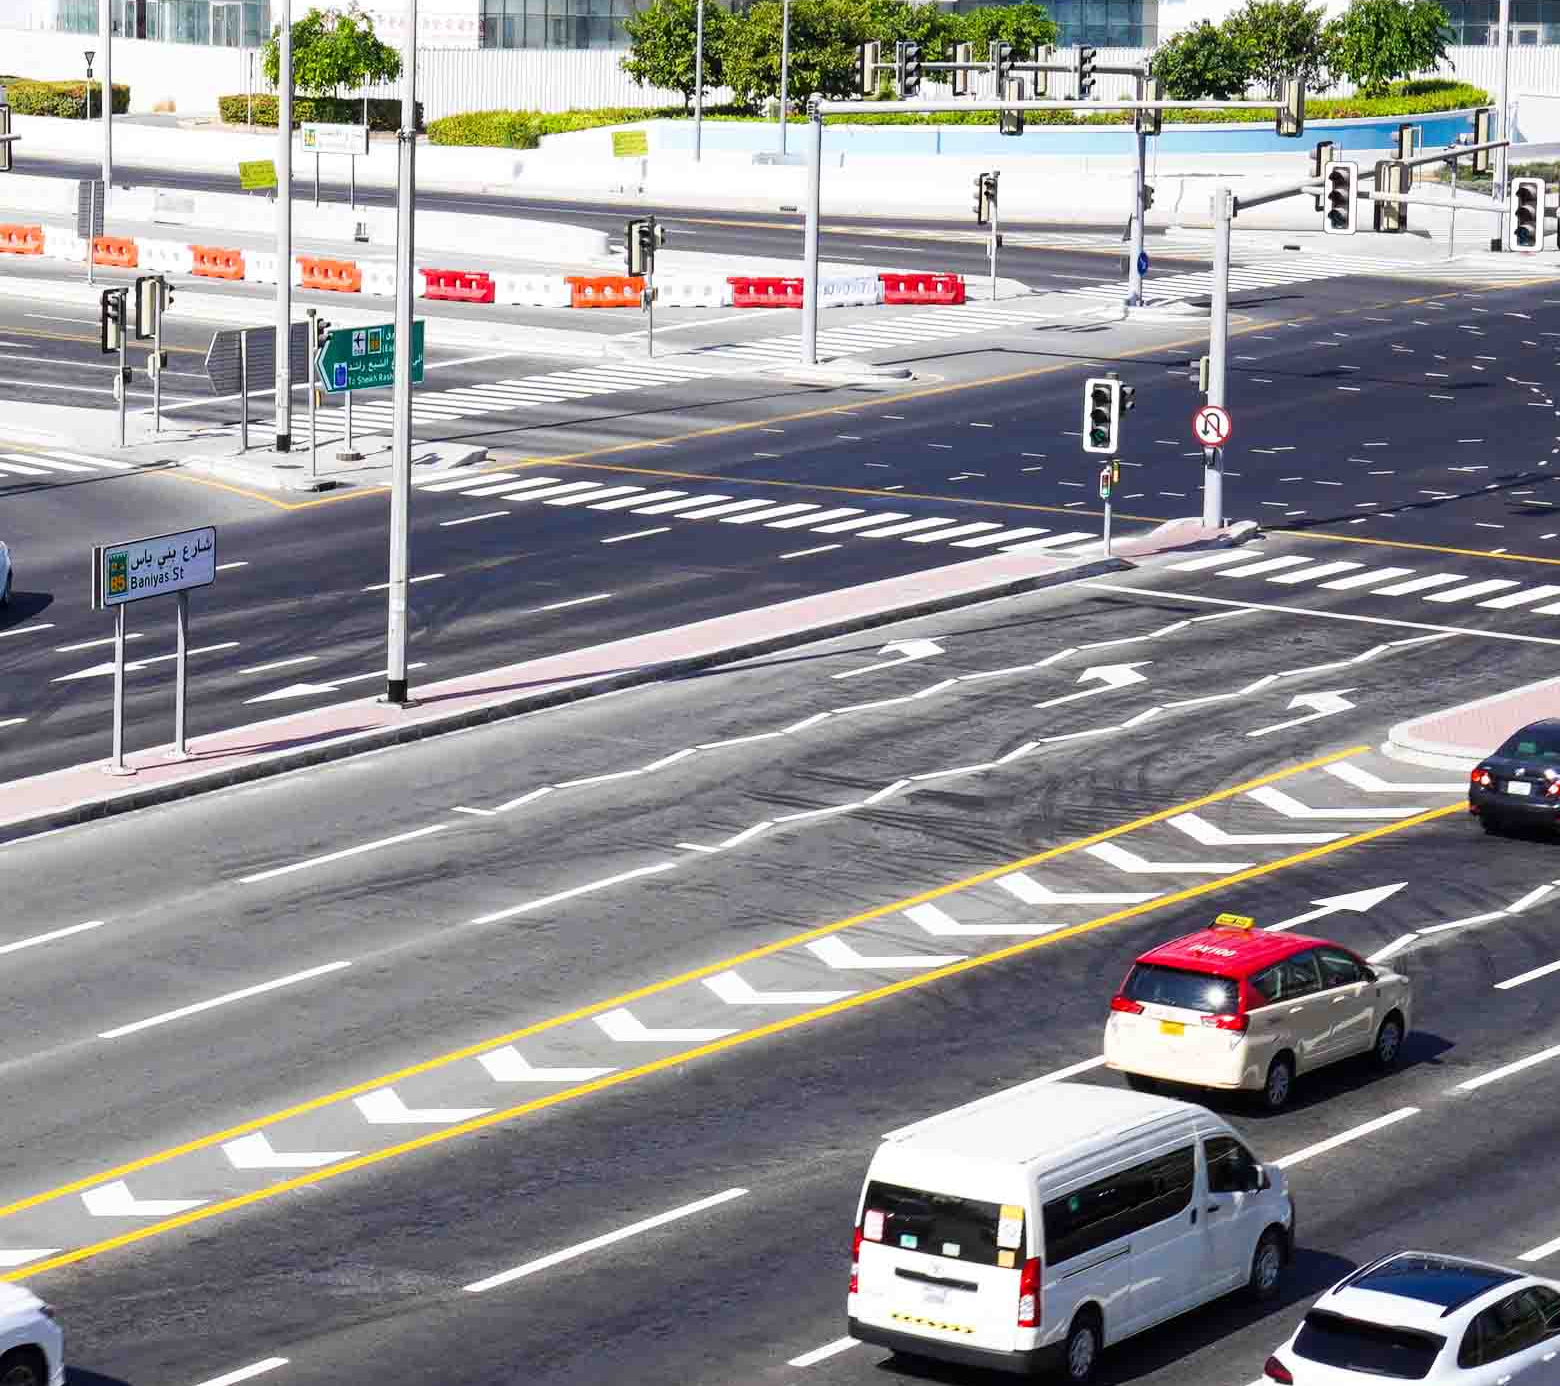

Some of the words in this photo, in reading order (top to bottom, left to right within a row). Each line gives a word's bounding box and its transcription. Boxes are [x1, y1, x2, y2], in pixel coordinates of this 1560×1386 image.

[131, 549, 153, 571] ياس
[157, 547, 177, 570] بني
[182, 537, 213, 562] شارع
[130, 571, 170, 590] Baniyas
[173, 566, 185, 581] St
